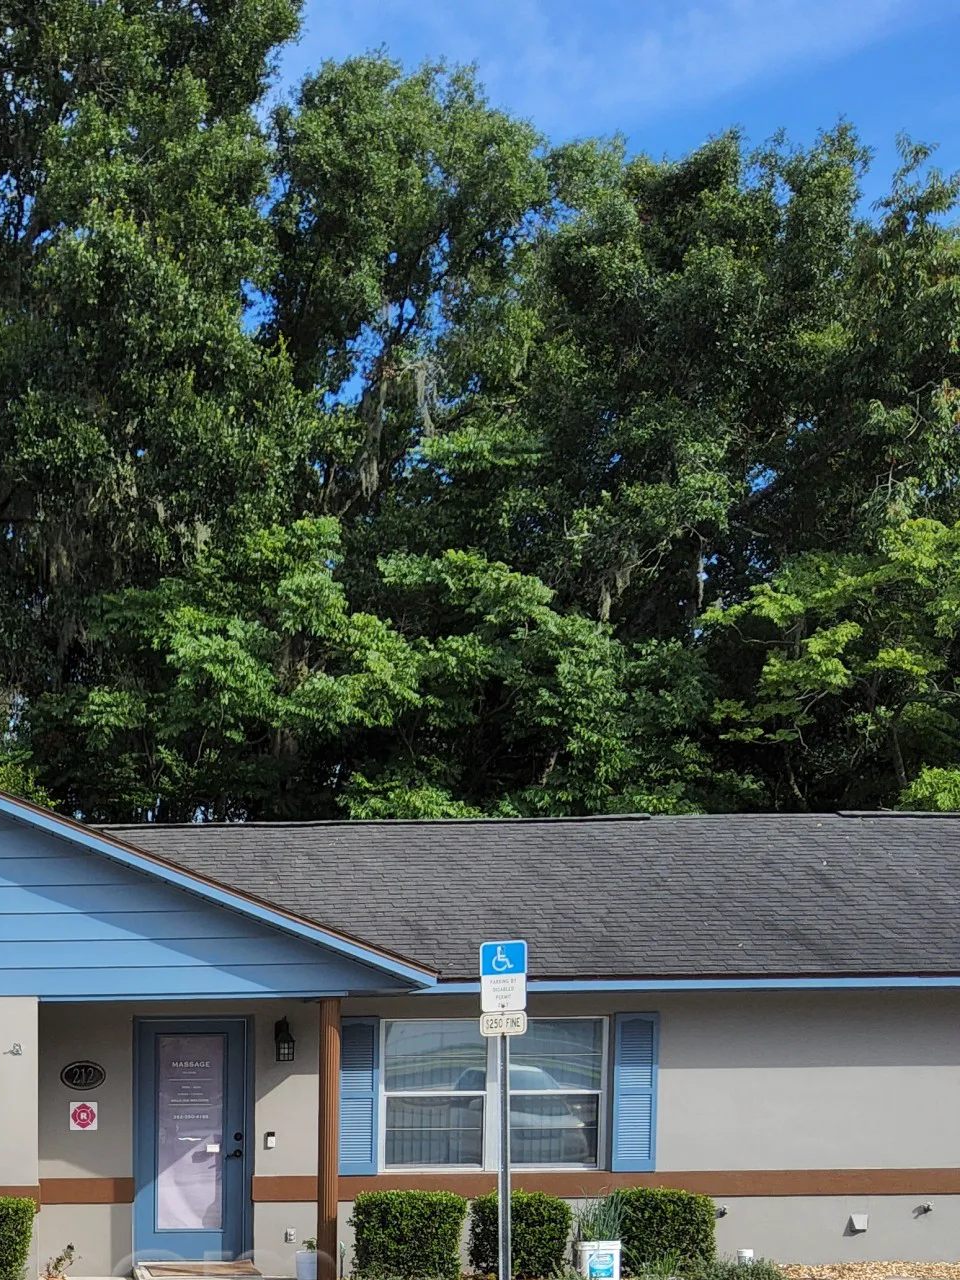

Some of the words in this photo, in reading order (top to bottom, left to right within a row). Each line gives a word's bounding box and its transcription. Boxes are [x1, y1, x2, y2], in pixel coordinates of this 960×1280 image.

[485, 1018, 503, 1029] $250
[505, 1017, 521, 1028] FINE
[72, 1067, 95, 1084] 212
[80, 1112, 88, 1120] R
